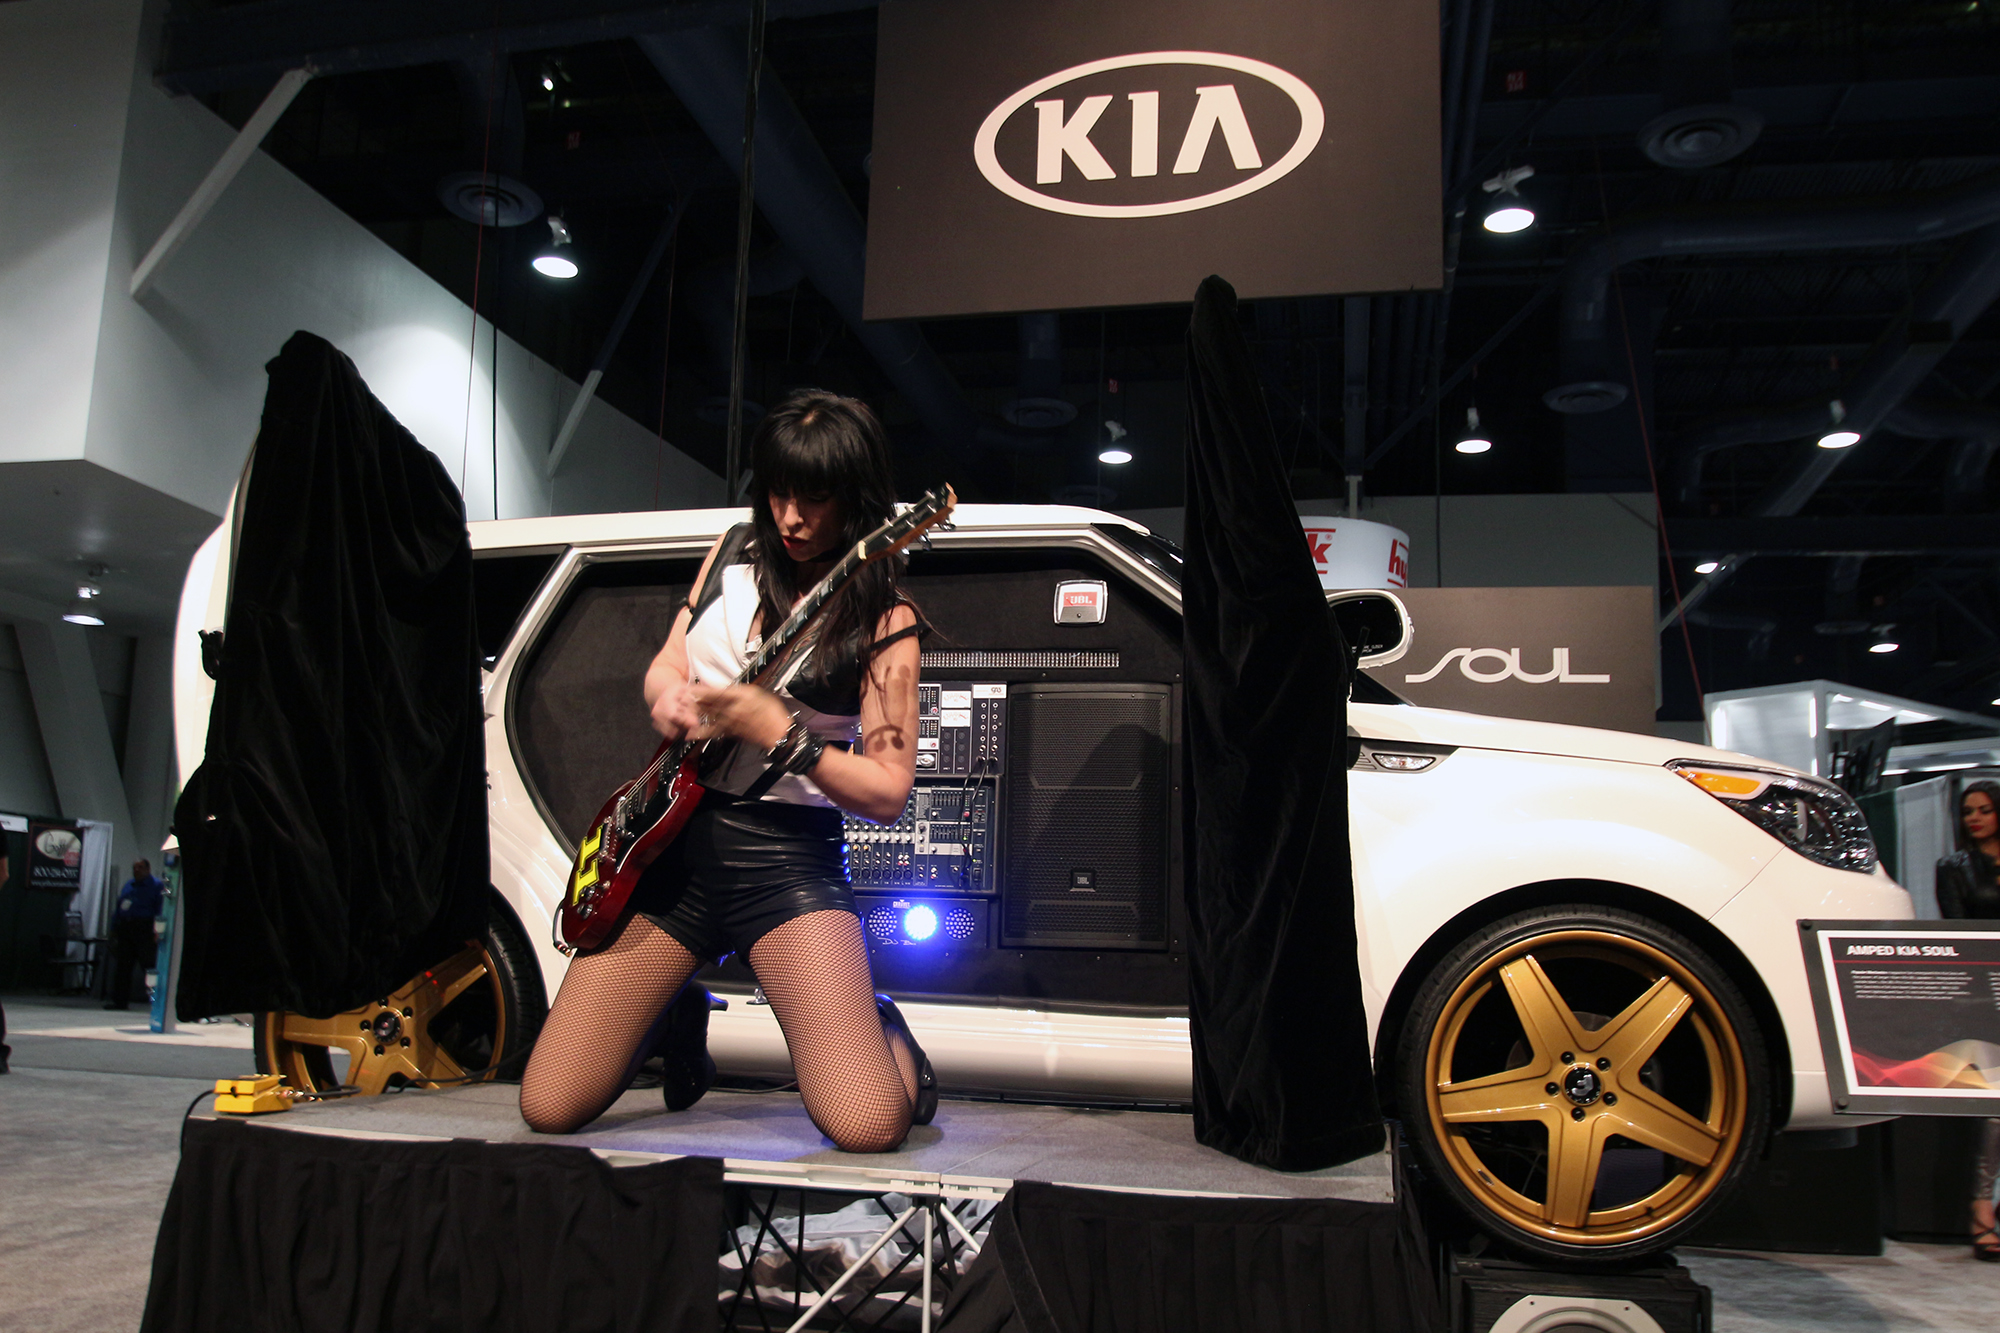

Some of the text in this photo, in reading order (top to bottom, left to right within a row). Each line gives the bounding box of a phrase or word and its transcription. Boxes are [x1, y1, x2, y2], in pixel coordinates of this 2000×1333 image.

[1034, 84, 1263, 185] KIA
[1070, 595, 1093, 604] JBL
[1404, 647, 1611, 684] SOUL
[1846, 945, 1960, 957] AMPED KIA SOUL
